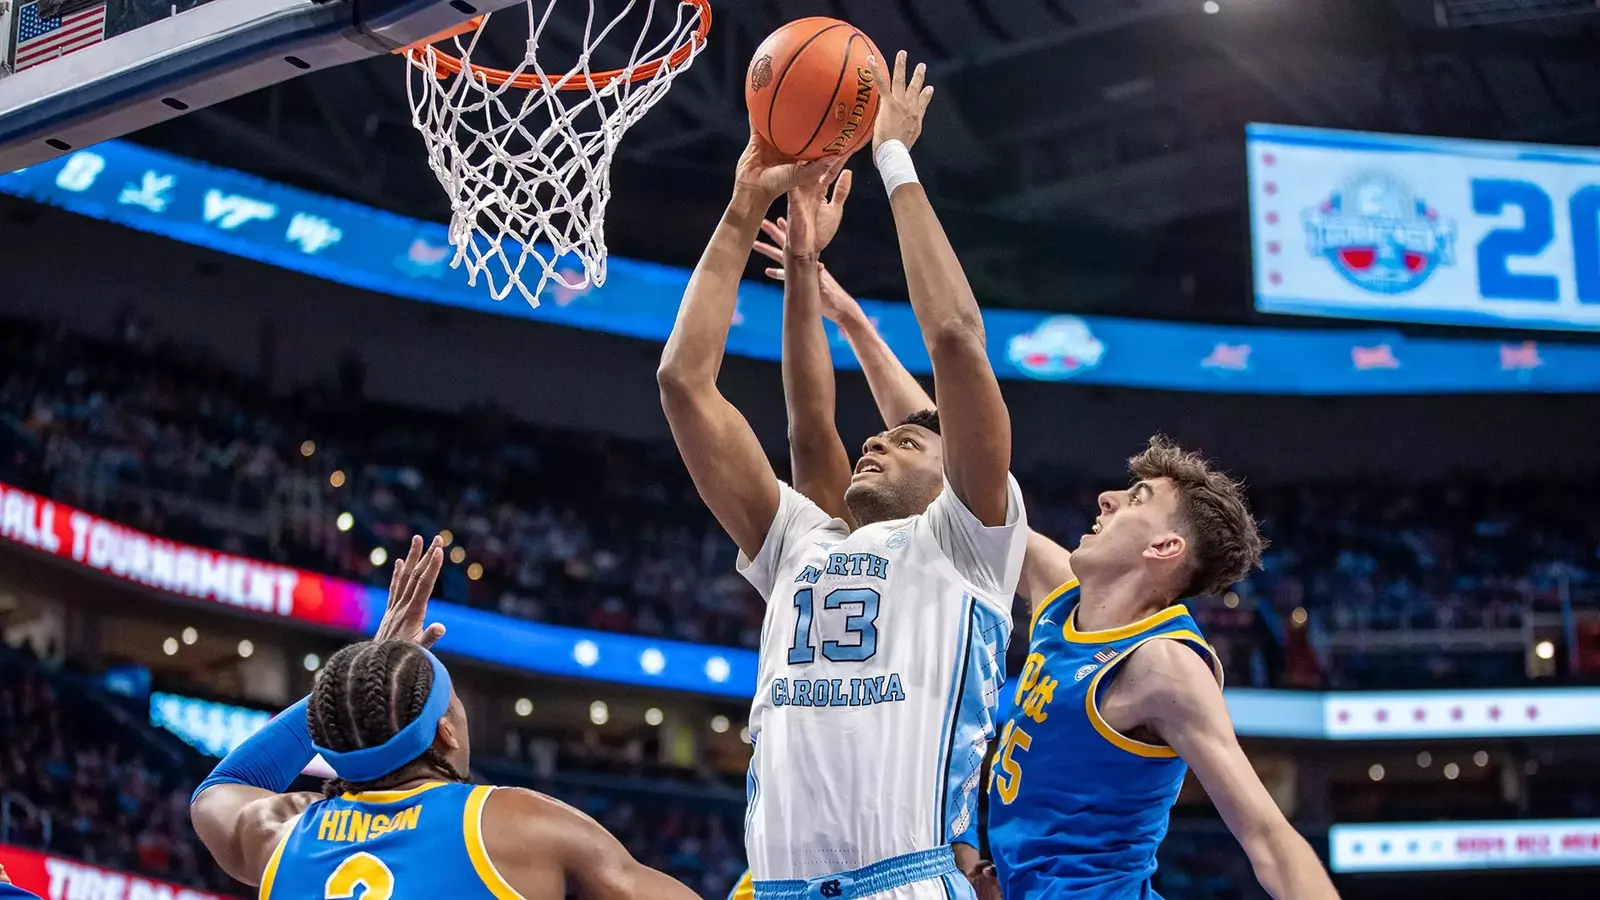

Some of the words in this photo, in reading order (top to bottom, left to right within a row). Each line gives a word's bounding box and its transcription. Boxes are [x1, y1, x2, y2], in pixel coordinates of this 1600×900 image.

[822, 65, 874, 155] SPALDING
[0, 486, 60, 553] ALL
[70, 510, 297, 616] TOURNAMENT
[794, 552, 889, 584] NRTH
[788, 587, 881, 666] 13
[771, 673, 905, 707] CAROLINA
[317, 805, 422, 842] HINSON
